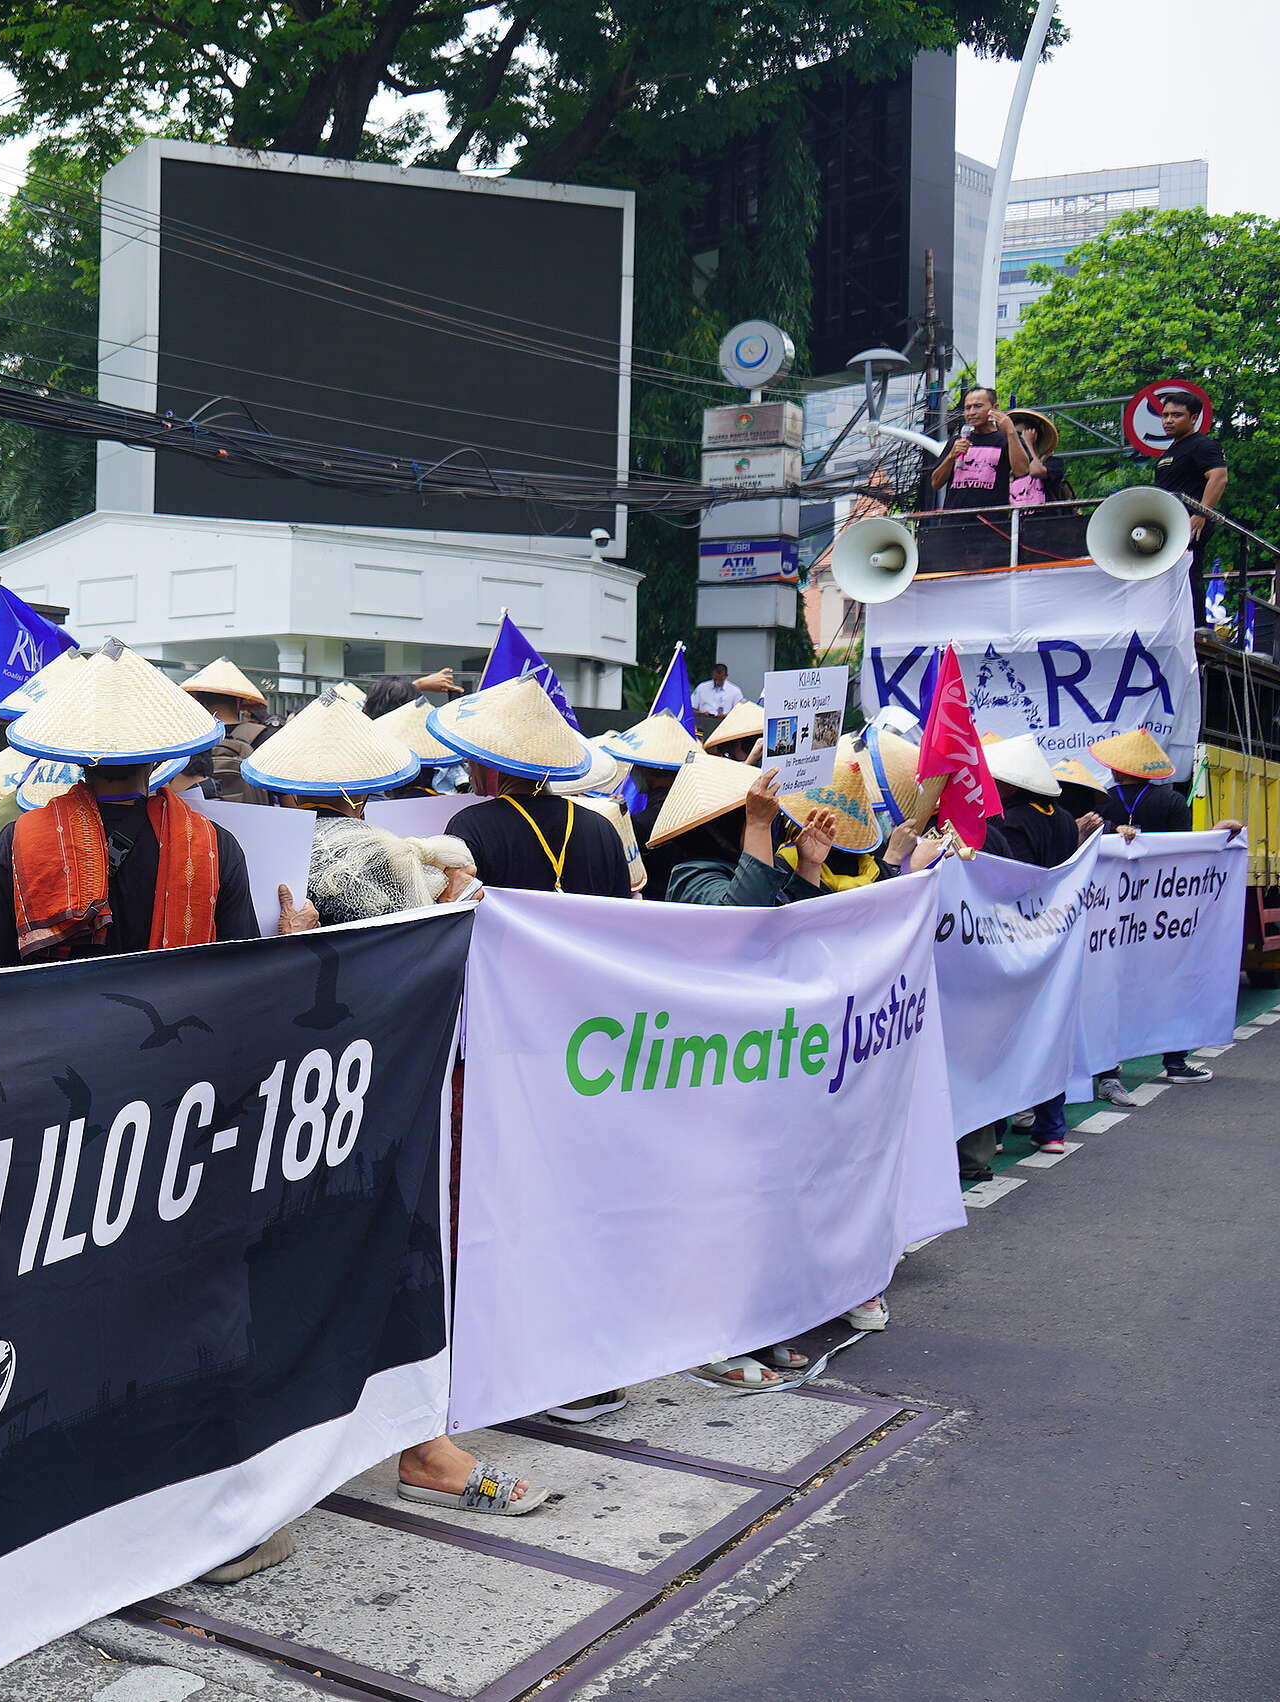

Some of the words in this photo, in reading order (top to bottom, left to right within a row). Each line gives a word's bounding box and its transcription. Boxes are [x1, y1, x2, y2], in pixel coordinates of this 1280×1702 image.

[722, 556, 755, 569] ATM
[798, 671, 822, 688] KIARA
[1118, 871, 1150, 903] Our
[1119, 911, 1147, 946] The
[1153, 907, 1199, 941] Sea!
[565, 1007, 830, 1097] Climate
[828, 974, 926, 1094] Justice
[17, 1100, 152, 1277] ILO
